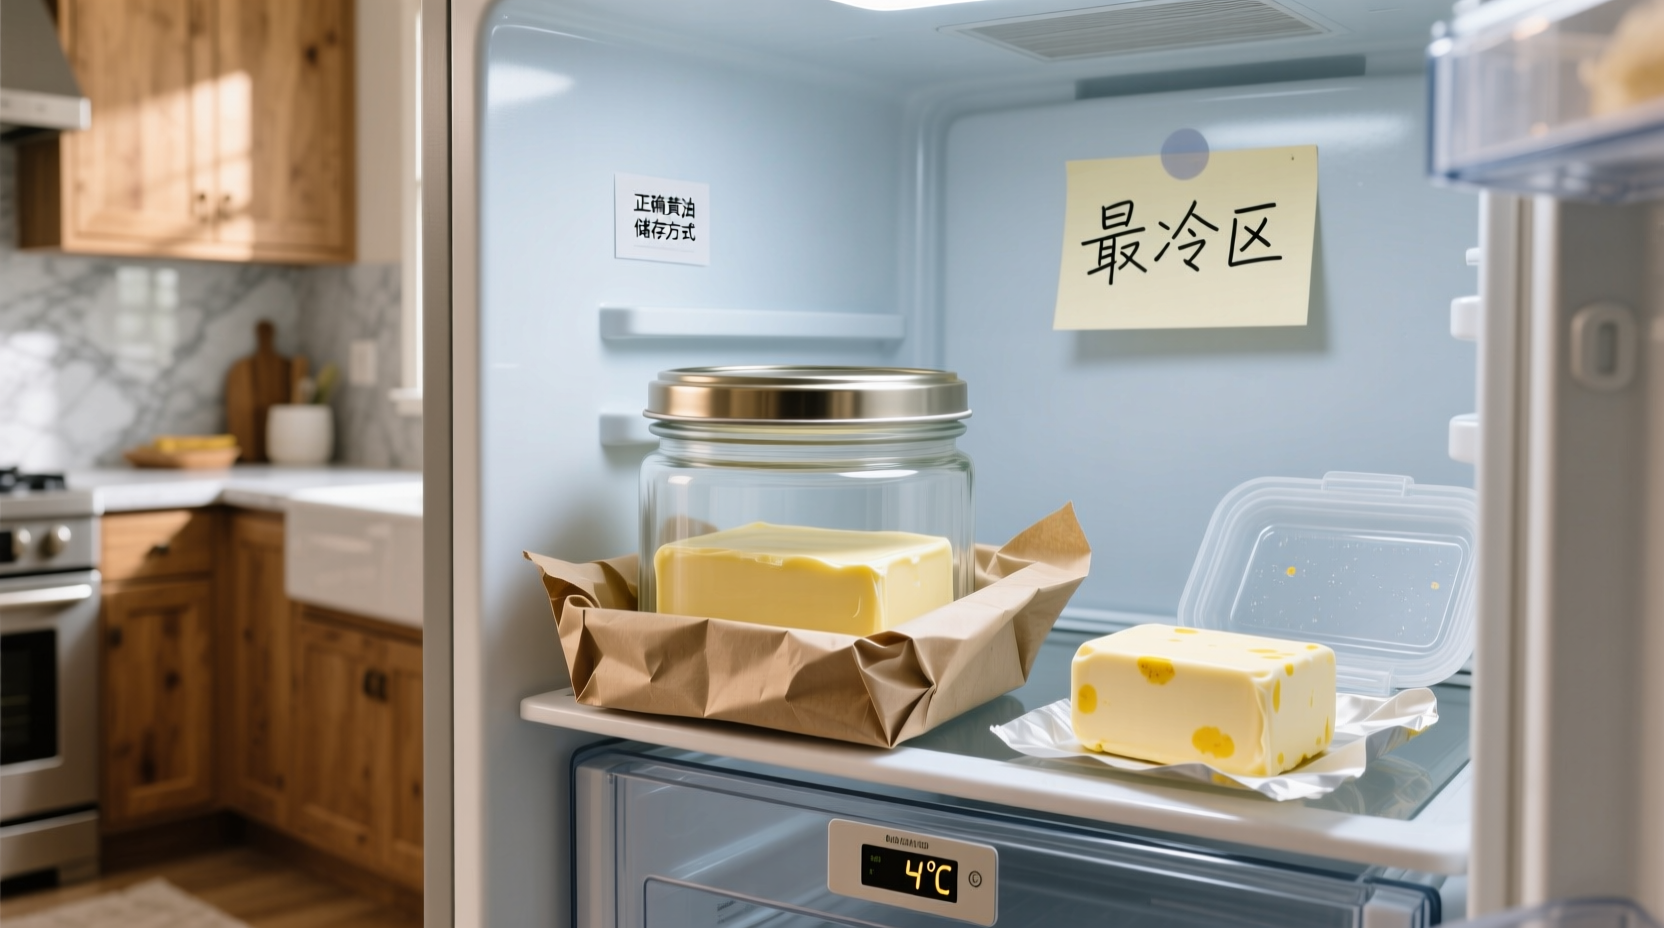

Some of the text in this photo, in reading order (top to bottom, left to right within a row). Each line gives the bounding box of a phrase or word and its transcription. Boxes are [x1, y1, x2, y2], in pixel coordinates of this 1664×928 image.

[633, 217, 696, 242] 储存方式
[1081, 199, 1283, 286] 最冷区
[905, 859, 952, 896] 4°C
